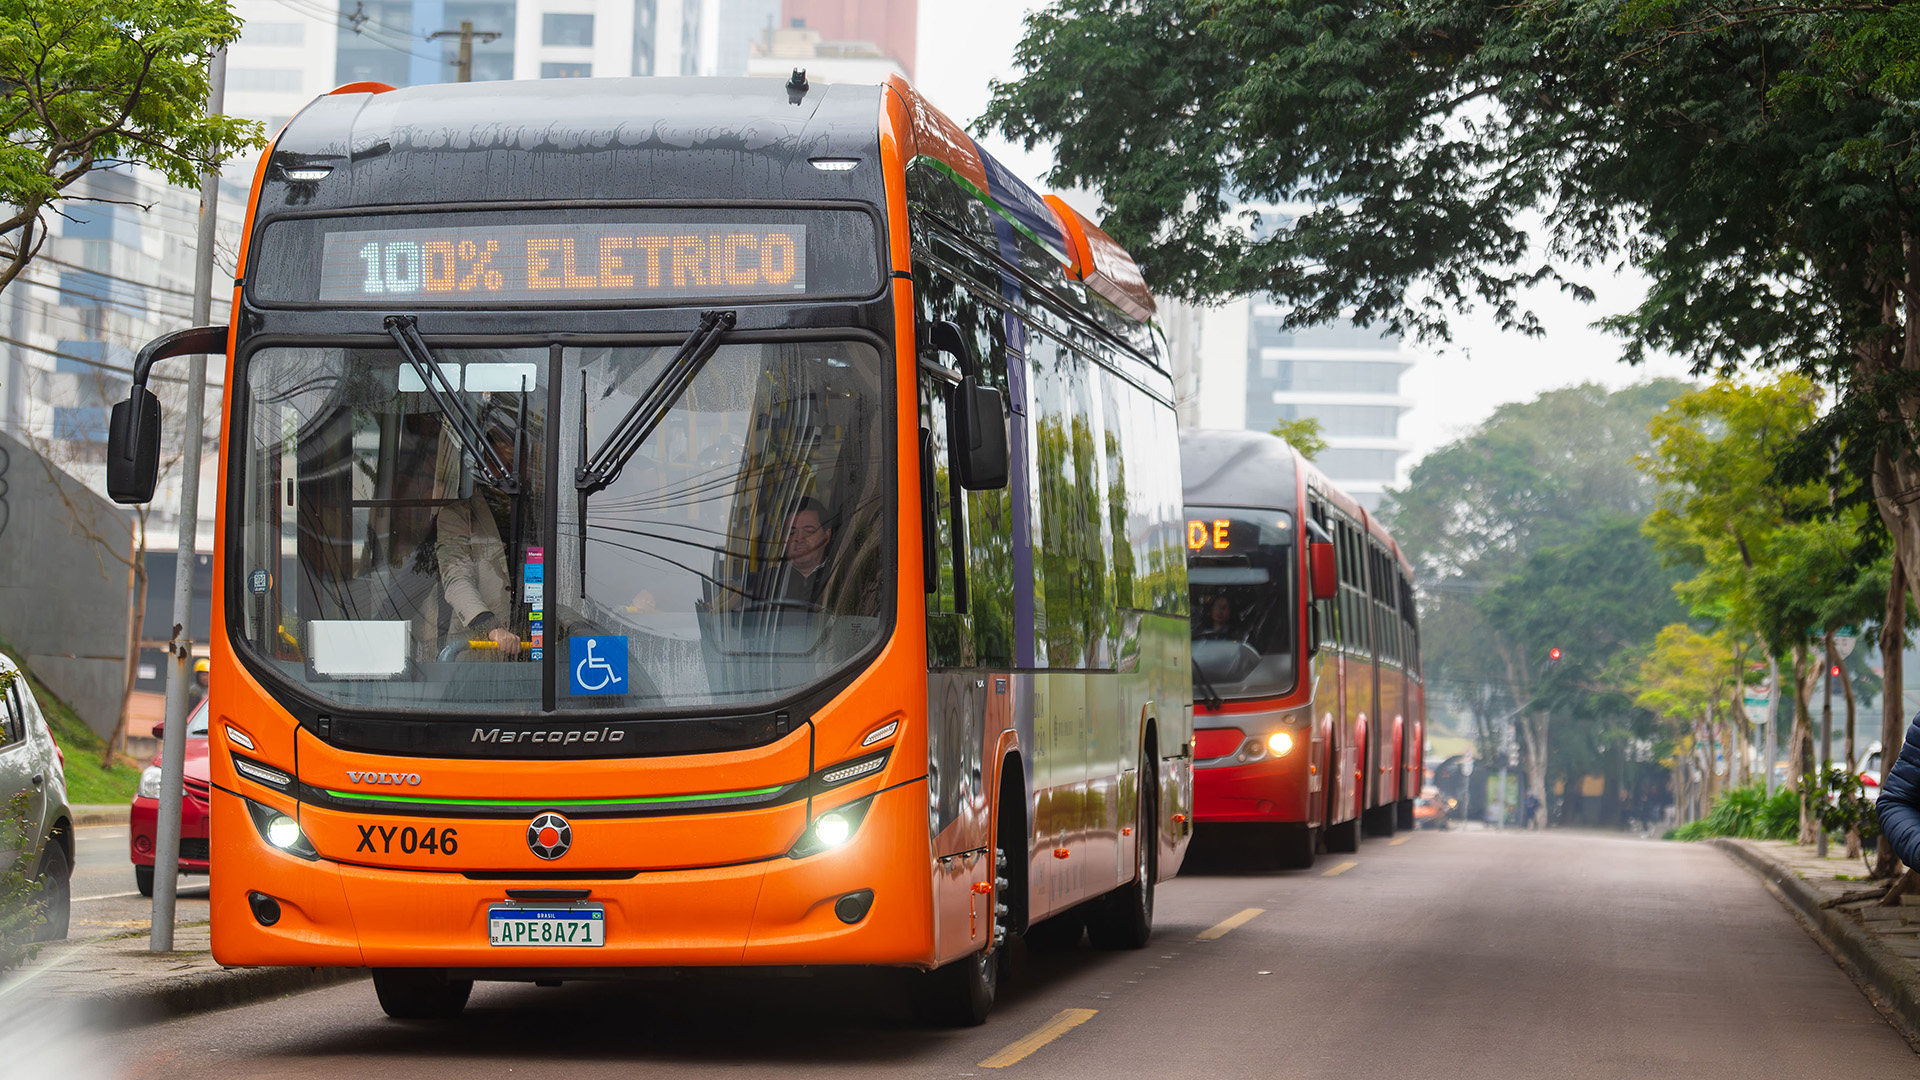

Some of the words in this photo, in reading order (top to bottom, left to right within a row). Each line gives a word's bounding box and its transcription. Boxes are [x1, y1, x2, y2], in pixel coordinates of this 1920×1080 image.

[360, 240, 503, 292] 100%
[527, 233, 795, 288] ELETRICO
[471, 727, 625, 745] Marcopolo
[346, 771, 421, 786] VOLVO
[356, 825, 458, 855] XY046
[501, 922, 592, 942] APE8A71
